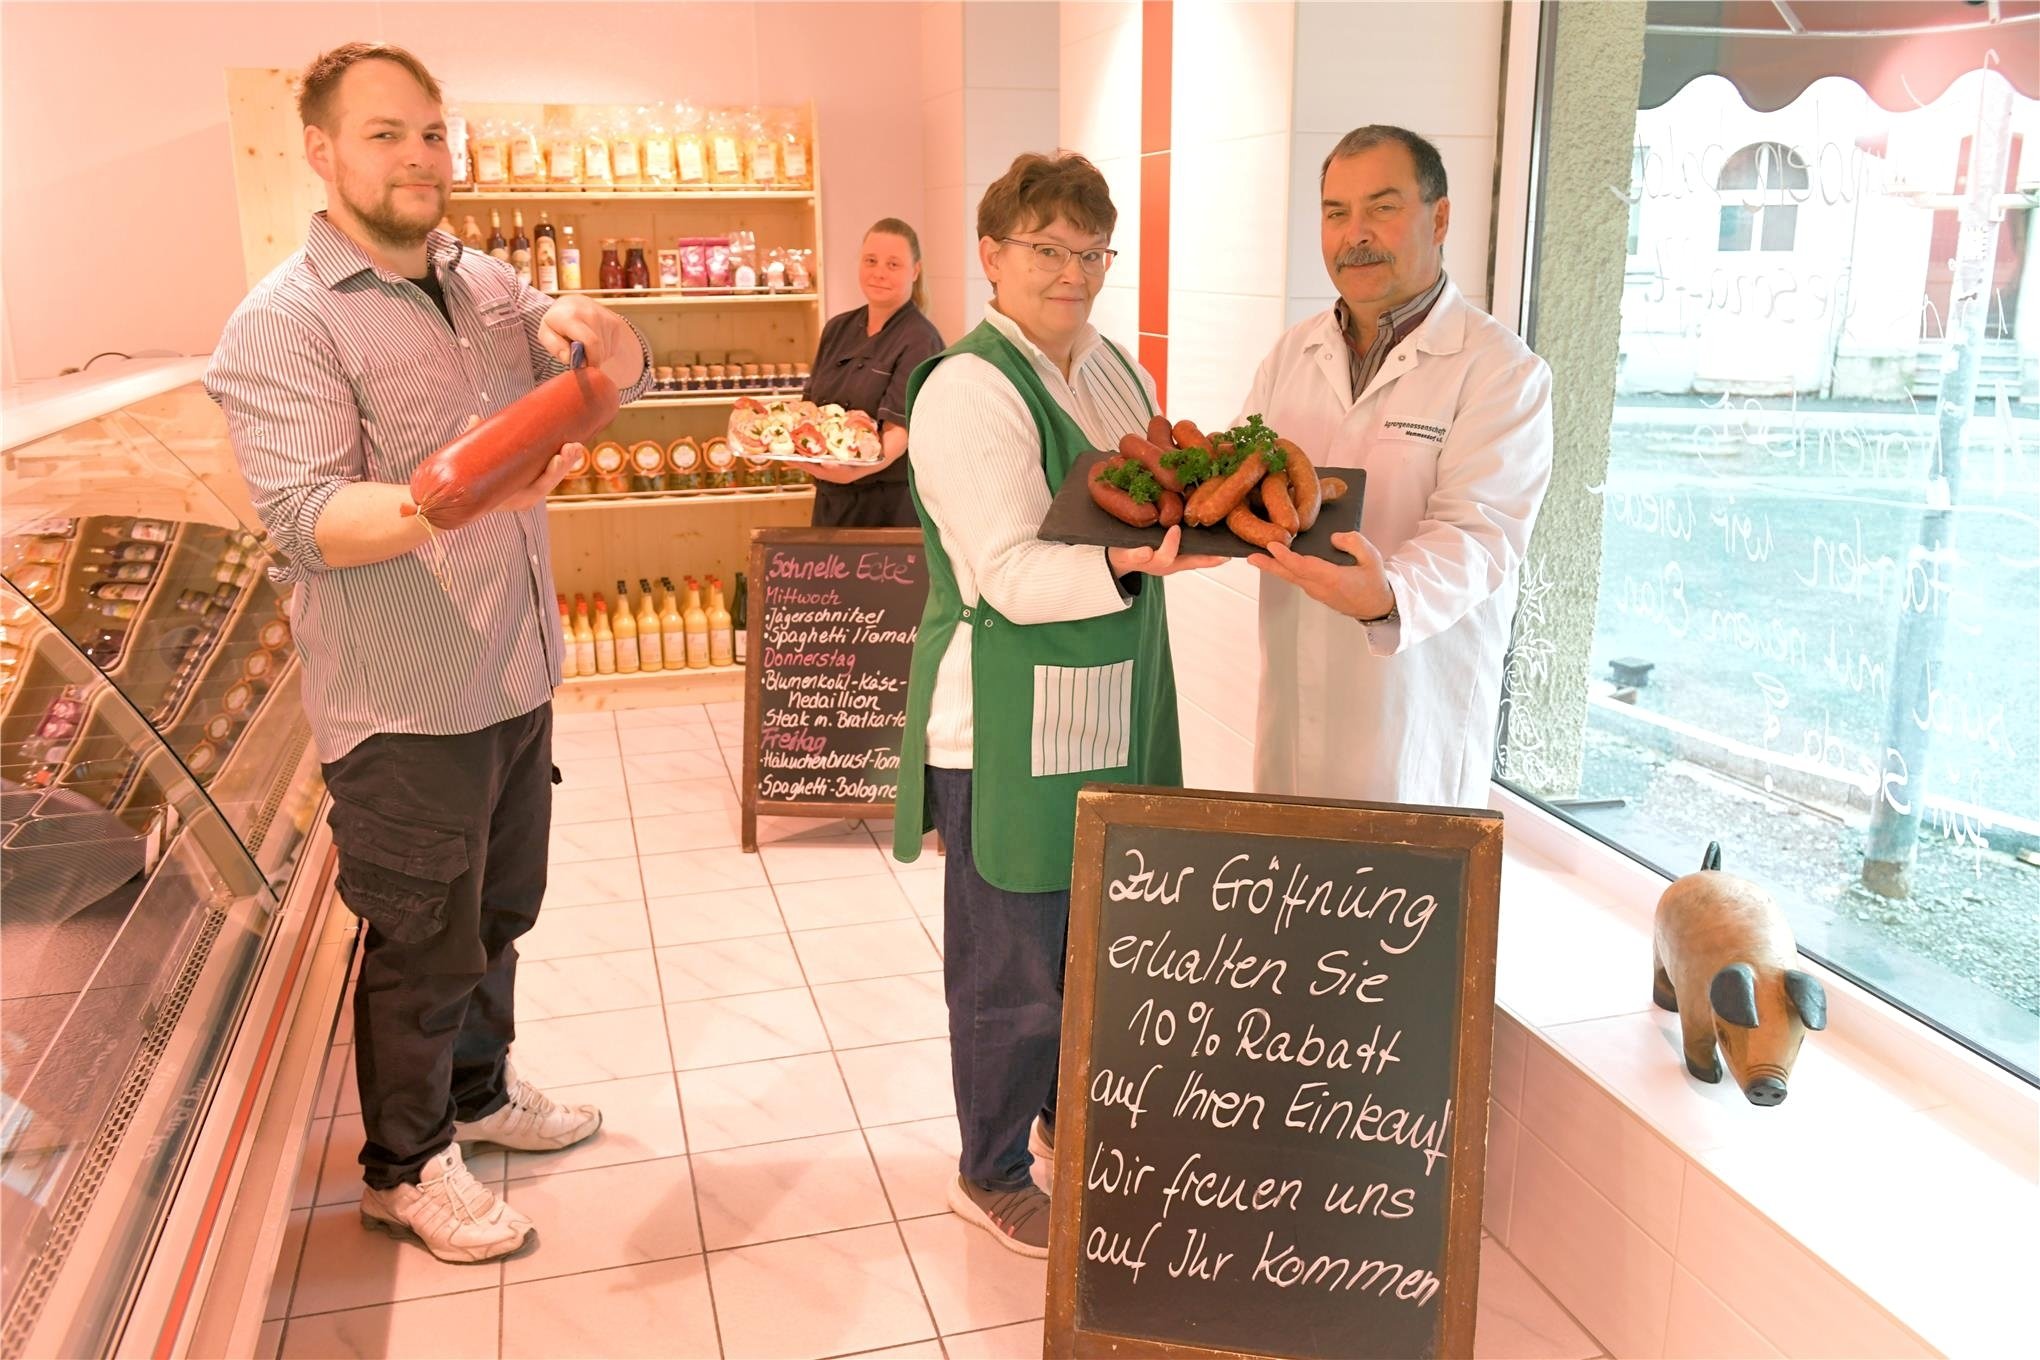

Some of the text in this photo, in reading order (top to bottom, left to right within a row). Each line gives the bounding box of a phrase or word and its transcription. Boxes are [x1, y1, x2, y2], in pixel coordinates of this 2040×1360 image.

[764, 585, 842, 605] Mittwoch
[763, 646, 857, 675] Donnerstag
[760, 727, 828, 757] Freitag
[763, 708, 811, 728] Steak
[1108, 848, 1438, 955] Zur Eröffnung
[1107, 930, 1390, 1003] erhalten Sie
[1234, 1007, 1402, 1075] Rabatt
[1089, 1064, 1454, 1177] auf Ihren Einkauf
[1087, 1140, 1416, 1219] Wir freuen uns
[1086, 1221, 1164, 1285] auf
[1167, 1227, 1234, 1282] Ihr
